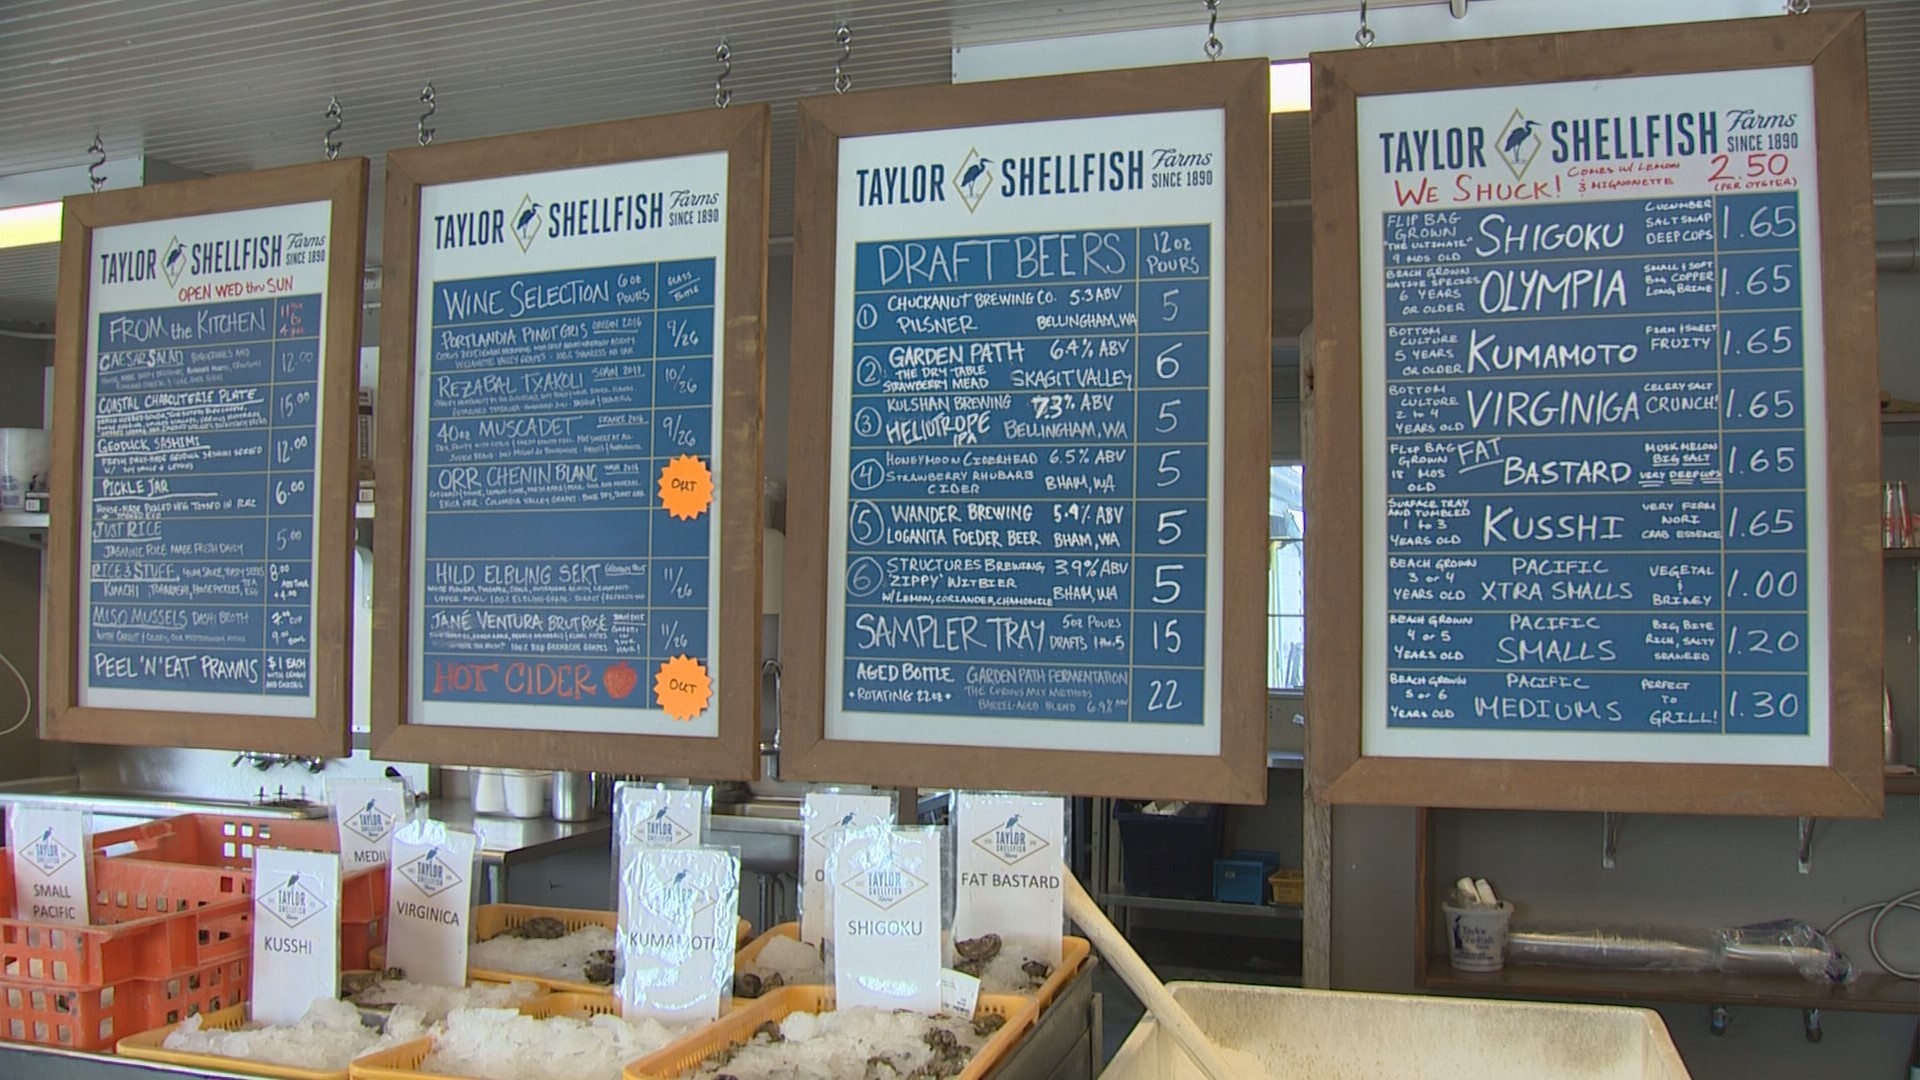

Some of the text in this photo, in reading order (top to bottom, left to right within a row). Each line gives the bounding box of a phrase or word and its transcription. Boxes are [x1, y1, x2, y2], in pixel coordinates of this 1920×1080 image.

[1380, 109, 1798, 174] TAYLOR SHELLFISH Farms
[1727, 132, 1798, 153] SINCE 1890
[857, 148, 1213, 206] TAYLOR SHELLFISH Farms
[1708, 154, 1788, 183] 2.50
[1152, 170, 1213, 188] SINCE 1890
[1394, 174, 1561, 206] WE SHUCK!
[435, 190, 719, 250] TAYLOR SHELLFISH Farms
[669, 208, 719, 227] SINCE 1890
[1387, 212, 1460, 228] FLIP BAG
[1724, 206, 1796, 239] 1.65
[1476, 214, 1624, 257] SHIGOKU
[100, 233, 326, 284] TAYLOR SHELLFISH Farms
[286, 250, 325, 265] SINCE 1890
[879, 232, 1125, 285] DRAFT BEERS
[1146, 254, 1199, 274] POURS
[1671, 271, 1714, 282] COPPER
[1721, 264, 1793, 297] 1.65
[179, 276, 293, 301] OPEN WED SUN
[617, 290, 650, 304] POURS
[1418, 289, 1461, 299] YEARS
[1480, 269, 1627, 313] OLYMPIA
[443, 280, 609, 320] WINE SELECTION
[888, 285, 1122, 312] CHUCKANUT BREWING ABV
[1162, 289, 1179, 321] 5
[110, 317, 168, 343] FROM
[171, 324, 192, 340] the
[197, 307, 266, 338] KITCHEN
[560, 324, 588, 339] GRIS
[897, 316, 977, 334] PILSNER
[1389, 326, 1440, 337] BOTTOM
[1651, 337, 1711, 351] FRUITY
[1724, 326, 1793, 356] 1.65
[889, 339, 1129, 367] GARDEN PATH ABV
[1156, 341, 1182, 379] 6
[1468, 329, 1638, 374] KUMAMOTO
[951, 365, 986, 377] TABLE
[953, 377, 989, 389] MEAD
[99, 389, 257, 414] COASTAL PLATE
[280, 392, 309, 418] 15.00
[888, 394, 1114, 413] KULSHAN BREWING ABV
[1467, 390, 1640, 428] VIRGINIGA
[1646, 396, 1719, 414] CRUNCH!
[1726, 389, 1794, 419] 1.65
[1156, 399, 1181, 433] 5
[478, 415, 583, 438] MUSCADET
[98, 435, 200, 452] GEODUCK SASHIMI
[953, 433, 977, 447] IPA
[1681, 441, 1717, 452] MELON
[277, 436, 307, 464] 12.00
[887, 452, 960, 466] HONEYMOON
[1094, 449, 1125, 464] ABV
[1157, 450, 1181, 488] 5
[1458, 437, 1631, 486] FAT BASTARD
[1729, 447, 1795, 473] 1.65
[438, 463, 597, 491] ORR CHENIN BLANC
[671, 478, 697, 492] OUT
[887, 469, 1033, 482] STRAWBERRY RHUBARB
[103, 479, 169, 496] PICKLE JAR
[276, 481, 304, 504] 6.00
[928, 484, 980, 495] CIDER
[891, 504, 1124, 525] WANDER BREWING ABV
[1662, 513, 1700, 524] NORI
[1729, 508, 1794, 538] 1.65
[93, 521, 162, 538] JUST RICE
[1157, 509, 1187, 545] 5
[1484, 506, 1624, 546] KUSSHI
[277, 529, 301, 550] 5.00
[887, 528, 1041, 548] LOGANITA FOEDER BEER
[1390, 534, 1461, 546] YEARS OLD
[93, 563, 174, 579] RICE STUFF
[437, 563, 474, 584] HILD
[887, 558, 1128, 577] STRUCTURES BREWING ABV
[1513, 557, 1608, 576] PACIFIC
[1650, 565, 1714, 580] VEGETAL
[948, 576, 1016, 589] WITBIER
[1152, 565, 1183, 604] 5
[1482, 581, 1633, 601] XTRA SMALLS
[1727, 571, 1798, 598] 1.00
[1653, 593, 1711, 607] BRINEY
[94, 607, 126, 625] MISO
[132, 610, 188, 627] MUSSELS
[219, 610, 249, 624] BROTH
[477, 611, 578, 630] VENTURA BRUT
[1510, 615, 1600, 631] PACIFIC
[856, 614, 1045, 653] SAMPLER TRAY
[1153, 620, 1181, 653] 15
[1729, 629, 1799, 655] 1.20
[1497, 637, 1616, 664] SMALLS
[1654, 651, 1709, 662] SEAWEED
[94, 653, 258, 683] PEEL PRAWNS
[286, 657, 306, 668] EACH
[433, 660, 596, 699] HOT CIDER
[857, 663, 954, 682] AGED BOTTLE
[1507, 674, 1589, 689] PACIFIC
[669, 679, 697, 694] OUT
[1642, 679, 1689, 691] PERFECT
[857, 689, 913, 702] ROTATING
[1148, 680, 1182, 711] 22
[1474, 696, 1621, 722] MEDIUMS
[1730, 692, 1798, 719] 1.30
[1650, 710, 1717, 726] GRILL!
[359, 813, 382, 827] TAYLOR
[647, 822, 672, 835] TAYLOR
[996, 832, 1026, 845] TAYLOR
[36, 844, 58, 856] TAYLOR
[354, 851, 385, 863] MEDIU
[418, 863, 443, 879] TAYLOR
[868, 871, 901, 887] TAYLOR
[961, 873, 1060, 889] FAT BASTARD
[33, 884, 71, 898] SMALL
[278, 889, 305, 906] TAYLOR
[33, 905, 75, 919] PACIFIC
[397, 902, 459, 925] VIRGINICA
[848, 920, 923, 936] SHIGOKU
[265, 937, 312, 953] KUSSHI
